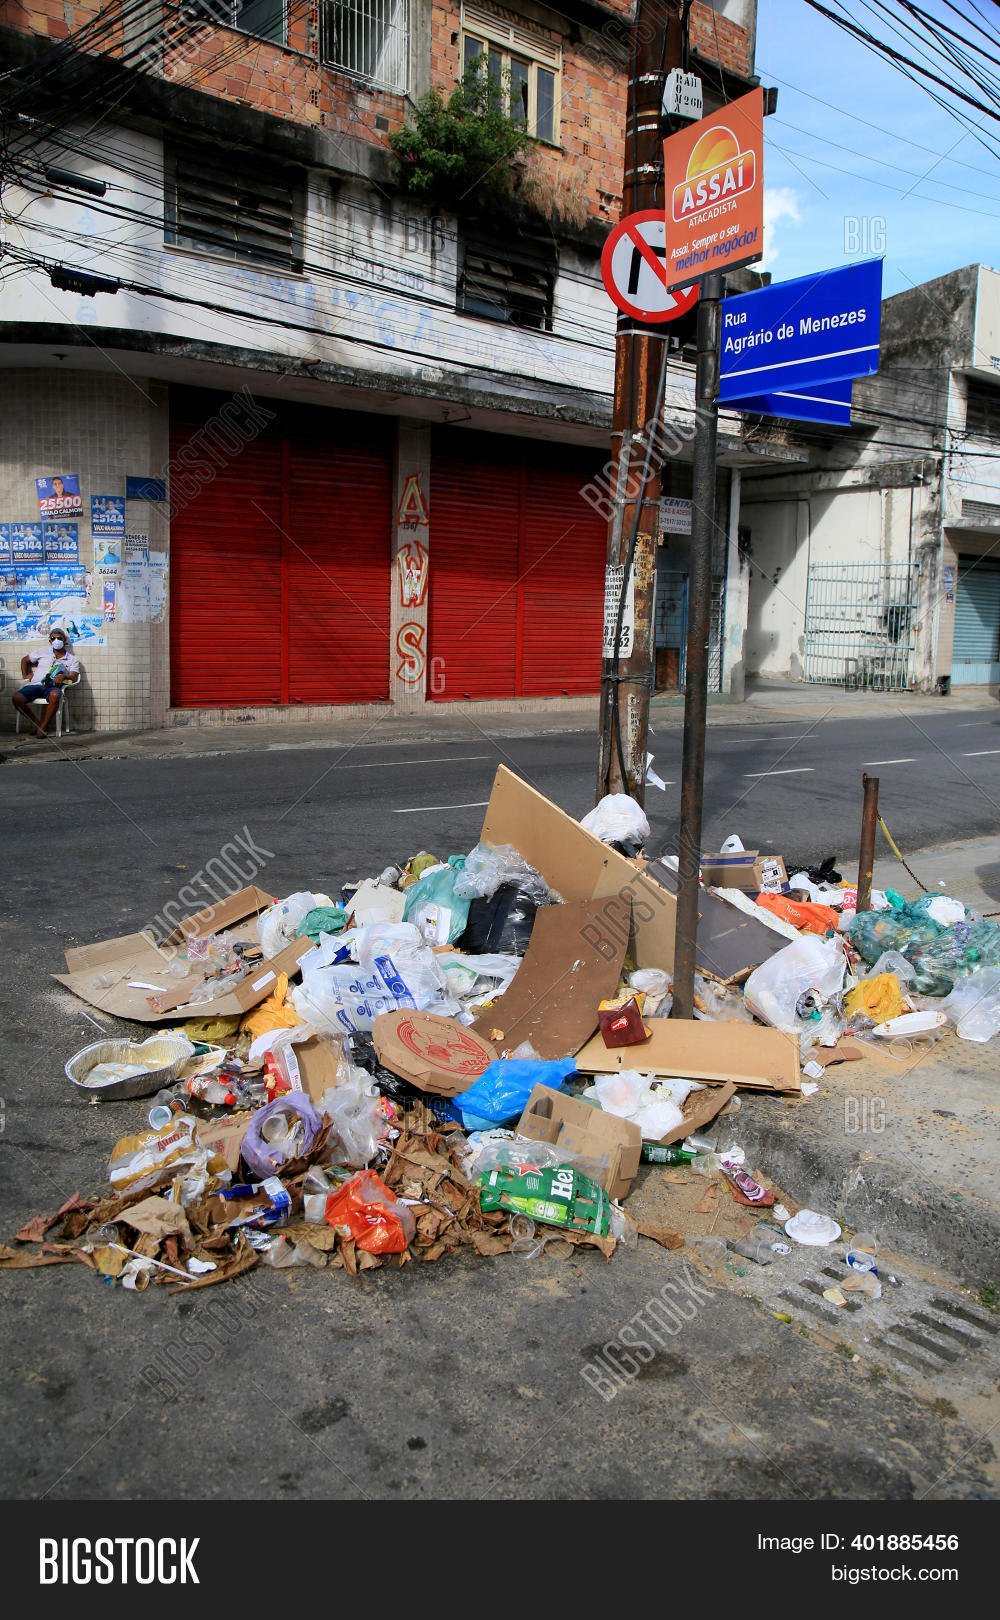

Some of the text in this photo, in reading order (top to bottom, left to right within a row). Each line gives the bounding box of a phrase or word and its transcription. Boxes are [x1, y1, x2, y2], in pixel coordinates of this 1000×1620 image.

[681, 158, 745, 213] ASSAÍ
[688, 200, 738, 229] ATACADISTA
[691, 231, 718, 253] Sempre
[719, 230, 726, 240] o
[726, 223, 740, 238] seu
[675, 226, 758, 273] melhor negócio!
[724, 308, 867, 354] Agrário de Menezes
[725, 312, 747, 328] Rua
[40, 495, 82, 511] 25500
[93, 513, 124, 523] 25144
[13, 541, 43, 551] 25144
[45, 541, 78, 551] 25144
